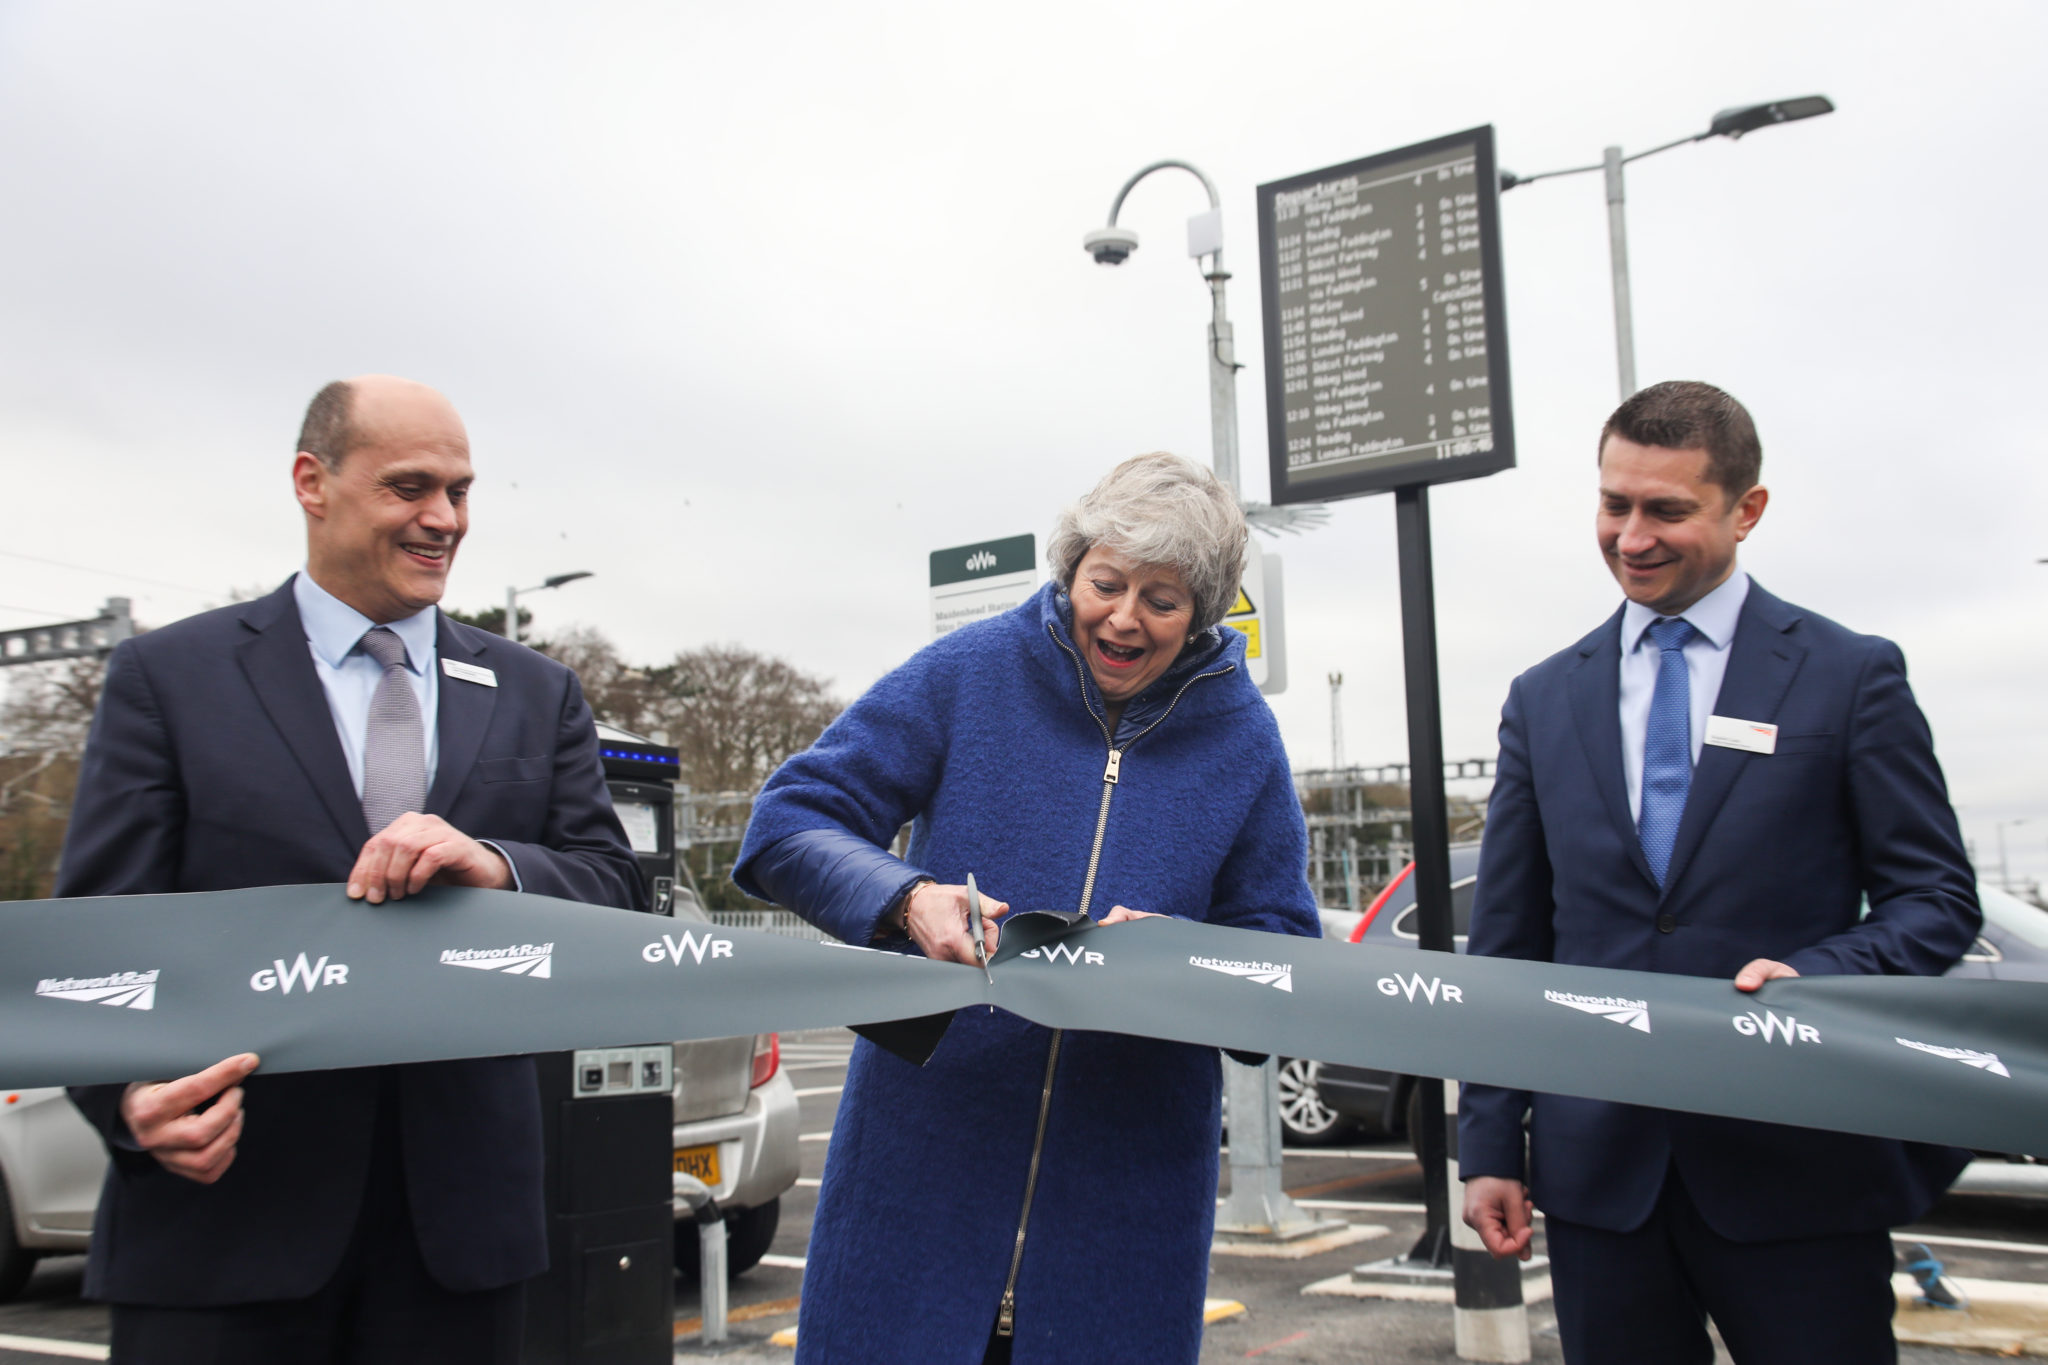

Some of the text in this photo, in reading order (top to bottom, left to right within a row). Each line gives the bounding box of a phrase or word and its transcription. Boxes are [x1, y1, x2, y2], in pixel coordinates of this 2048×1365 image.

[1275, 176, 1358, 208] Departures
[966, 550, 998, 571] GWR
[642, 929, 734, 967] GWR
[250, 951, 350, 995] GWR
[1376, 971, 1464, 1006] GWR
[1732, 1009, 1823, 1047] GWR
